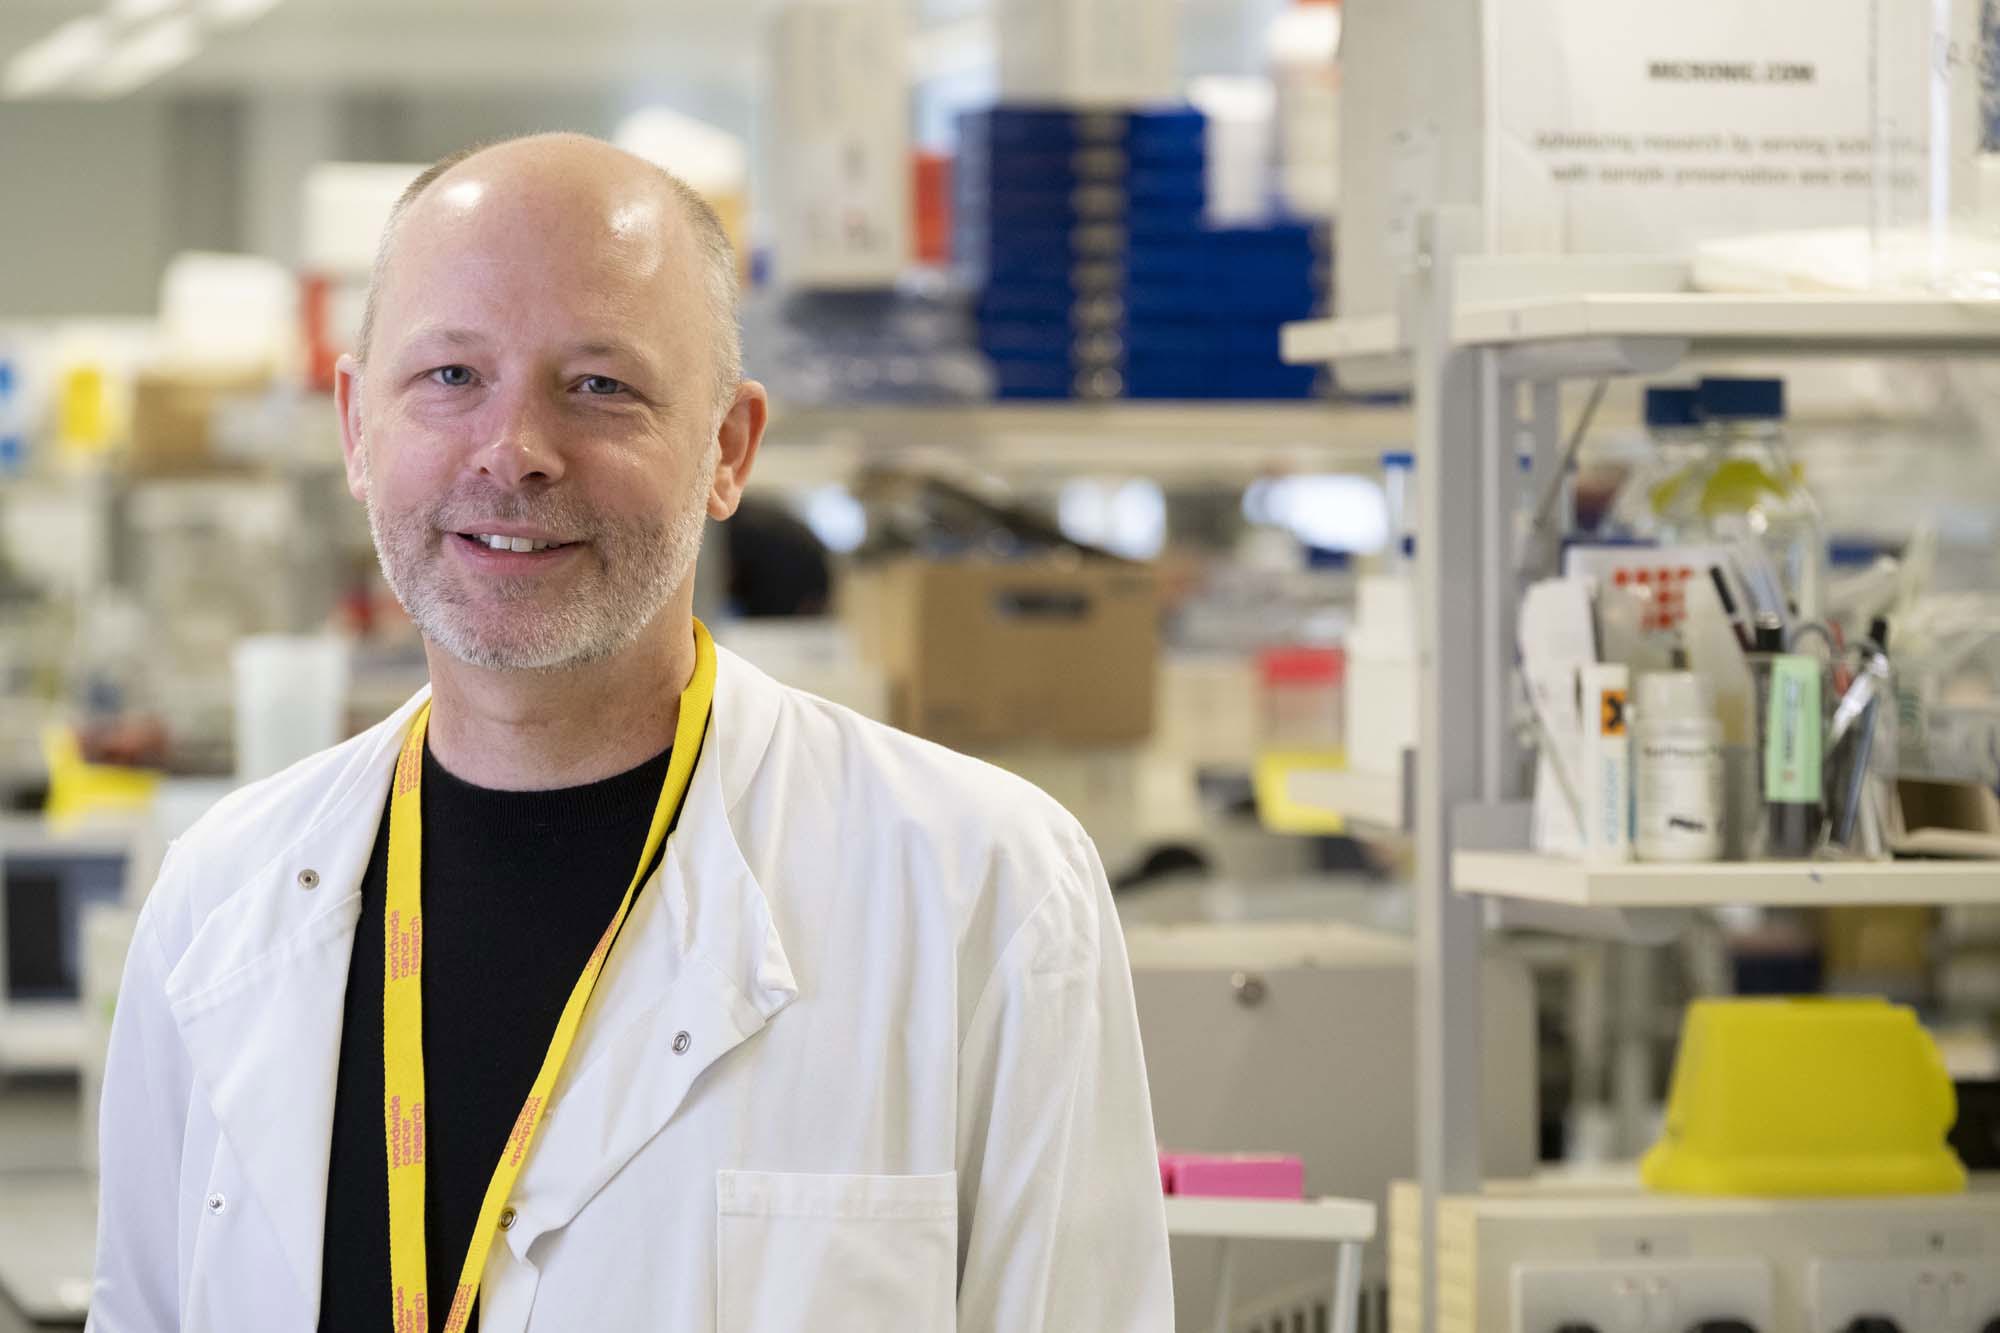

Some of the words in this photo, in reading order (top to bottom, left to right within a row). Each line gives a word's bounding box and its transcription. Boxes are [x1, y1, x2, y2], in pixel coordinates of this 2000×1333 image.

[390, 911, 400, 980] worldwide
[401, 932, 410, 977] cancer
[410, 916, 420, 975] research
[390, 1096, 401, 1168] worldwide
[402, 1120, 411, 1166] cancer
[411, 1104, 423, 1163] research
[510, 1096, 541, 1167] worldwide
